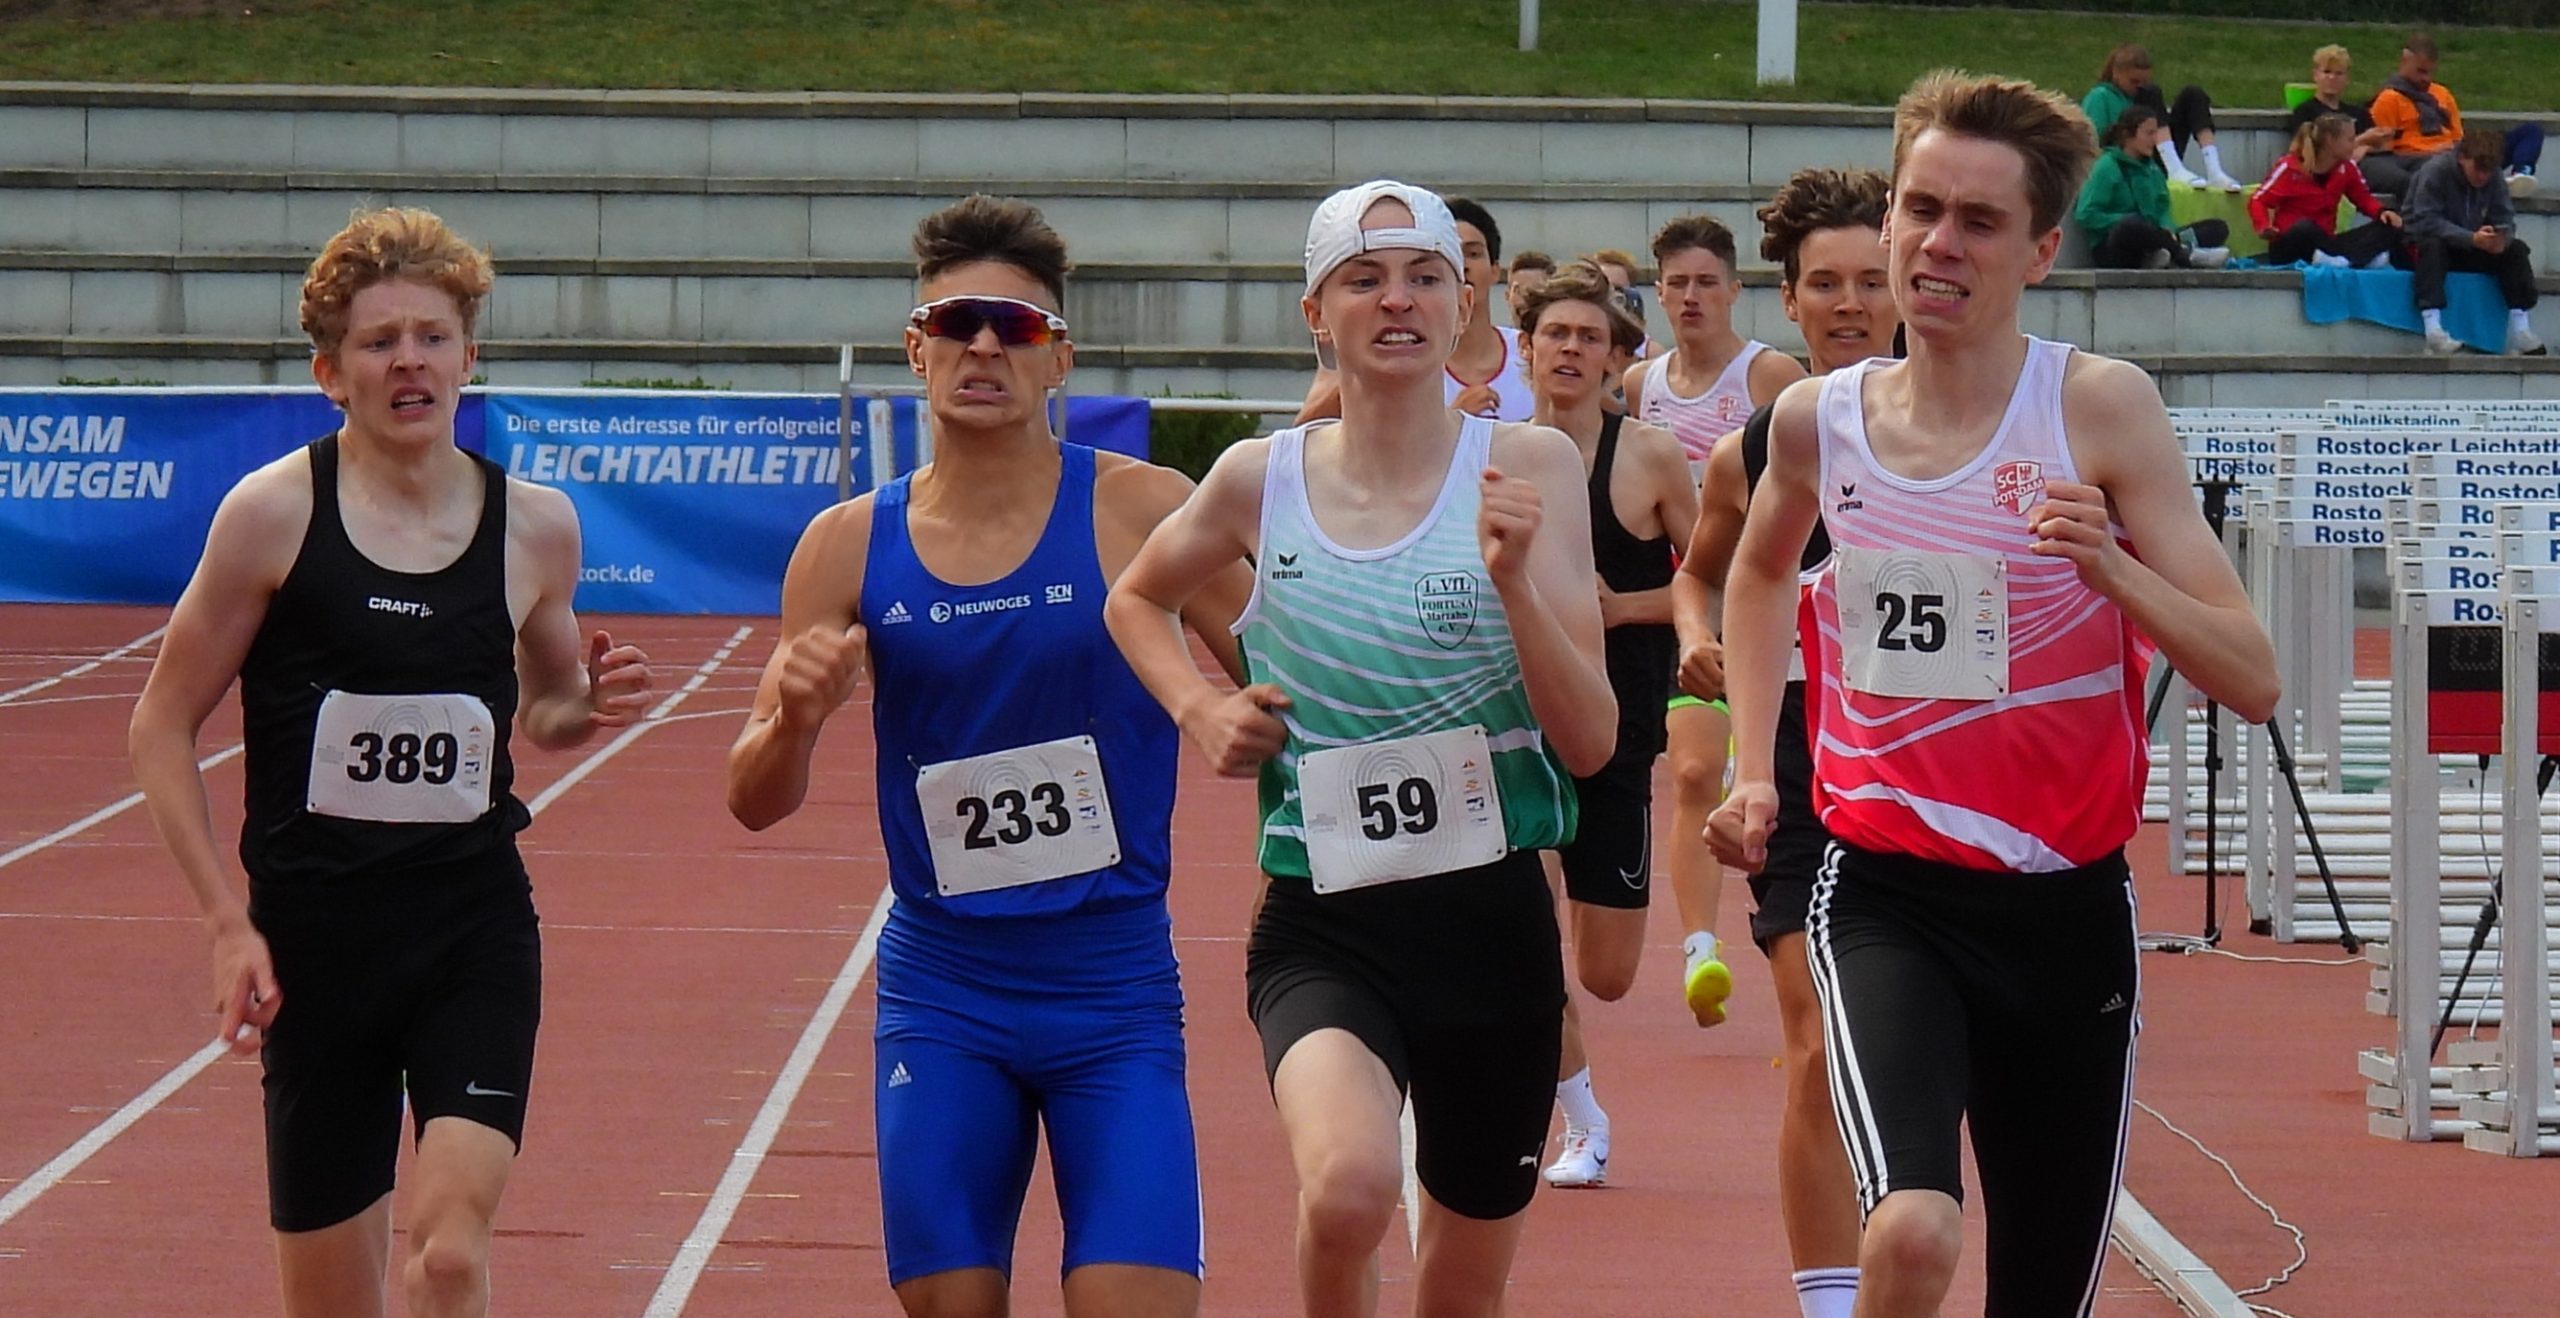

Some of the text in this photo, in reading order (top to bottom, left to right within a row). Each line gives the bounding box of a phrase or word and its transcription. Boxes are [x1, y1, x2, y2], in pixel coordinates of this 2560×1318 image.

[0, 416, 126, 453] NSAM
[507, 415, 862, 440] Die erste Adresse für erfolgreice
[2317, 436, 2442, 454] Rostocker
[509, 444, 861, 484] LEICHTATHLETIK
[2317, 461, 2410, 475] Rostoc
[1997, 471, 2017, 489] SC
[2315, 481, 2413, 498] Rostock
[1994, 478, 2045, 505] POTSDAM
[2461, 482, 2560, 499] Rostoc
[2312, 504, 2382, 520] Rosto
[2315, 525, 2384, 543] Rosto
[1046, 584, 1072, 599] SCN
[368, 597, 420, 616] CRAFT
[955, 595, 1031, 616] NEUWOGES
[1876, 592, 1946, 653] 25
[347, 732, 458, 784] 389
[956, 782, 1071, 850] 233
[1357, 777, 1438, 841] 59
